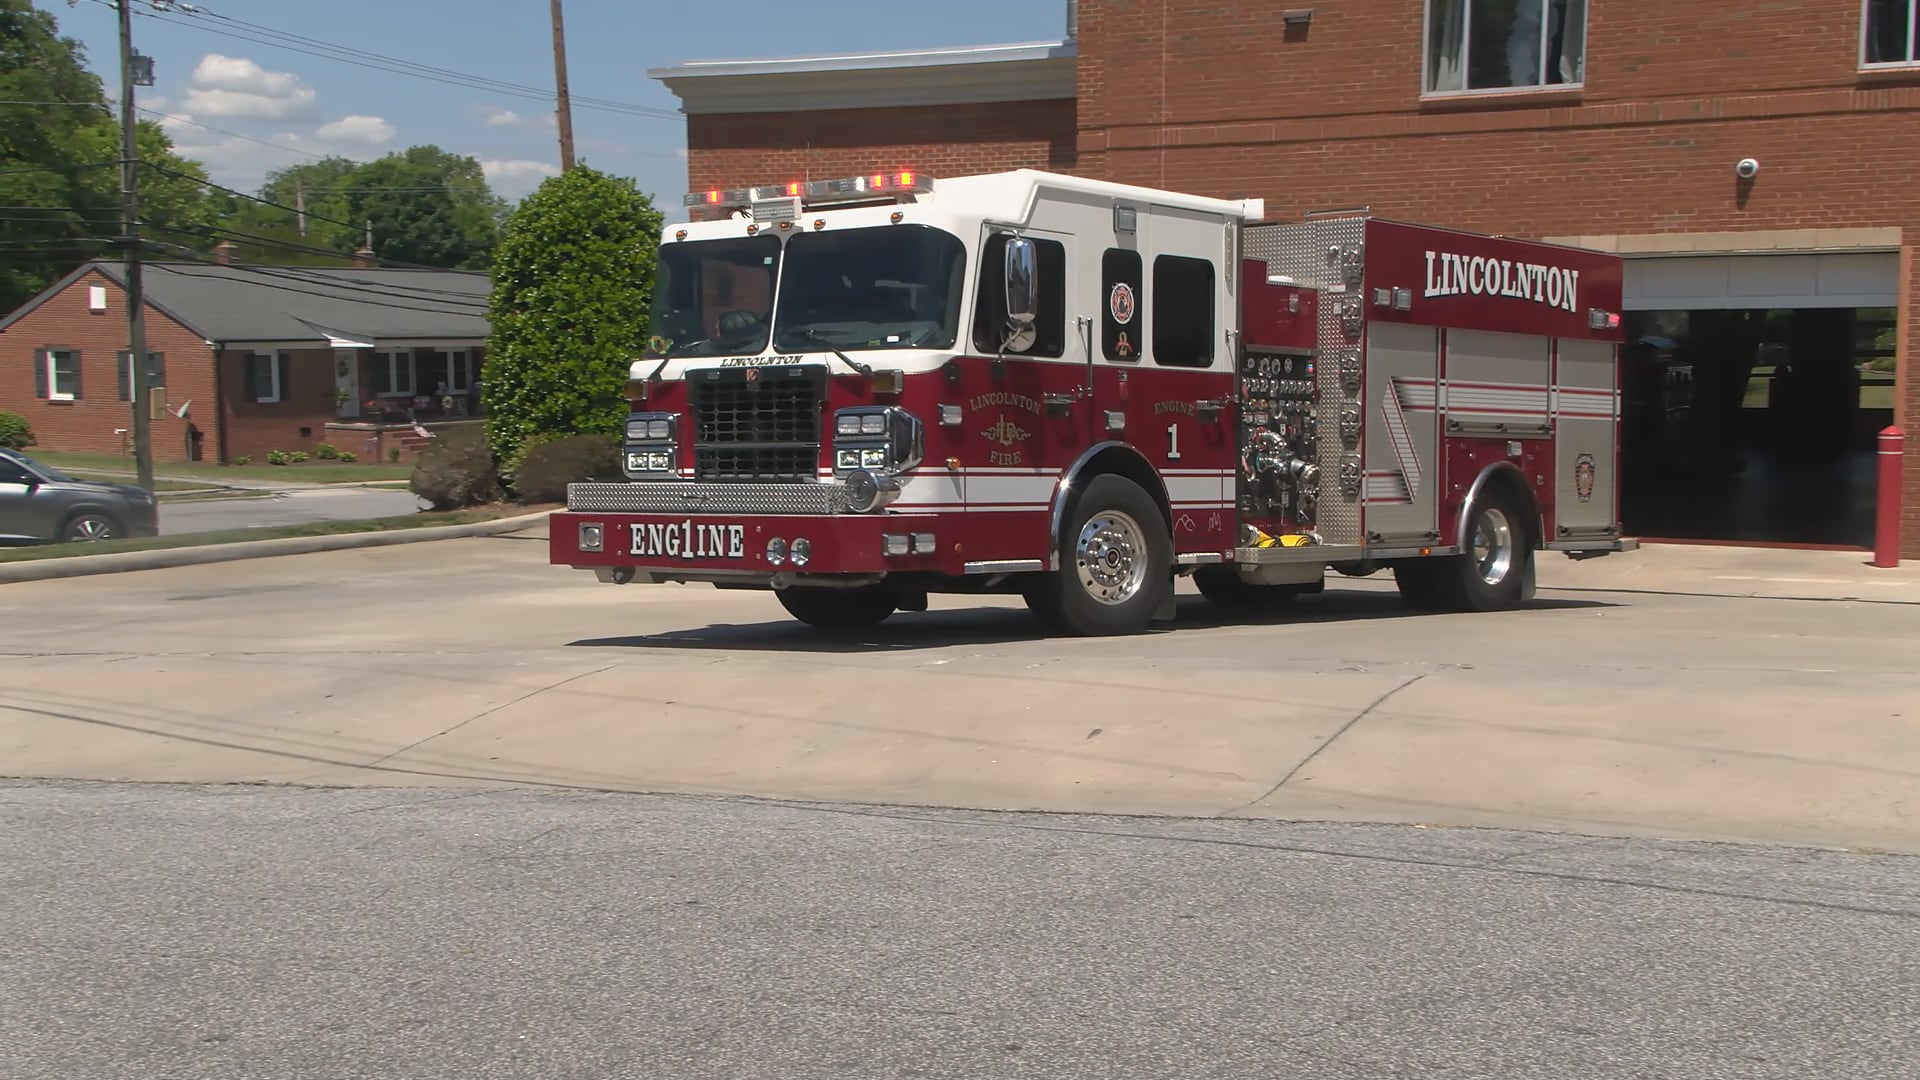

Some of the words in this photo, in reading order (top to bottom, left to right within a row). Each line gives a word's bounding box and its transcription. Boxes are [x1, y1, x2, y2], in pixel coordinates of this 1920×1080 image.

[1424, 250, 1579, 313] LINCOLNTON
[720, 355, 803, 367] LINCOLNTON
[970, 392, 1040, 415] LINCOLNTON
[1153, 400, 1195, 416] ENGINE
[1167, 423, 1181, 459] 1
[990, 450, 1022, 466] FIRE
